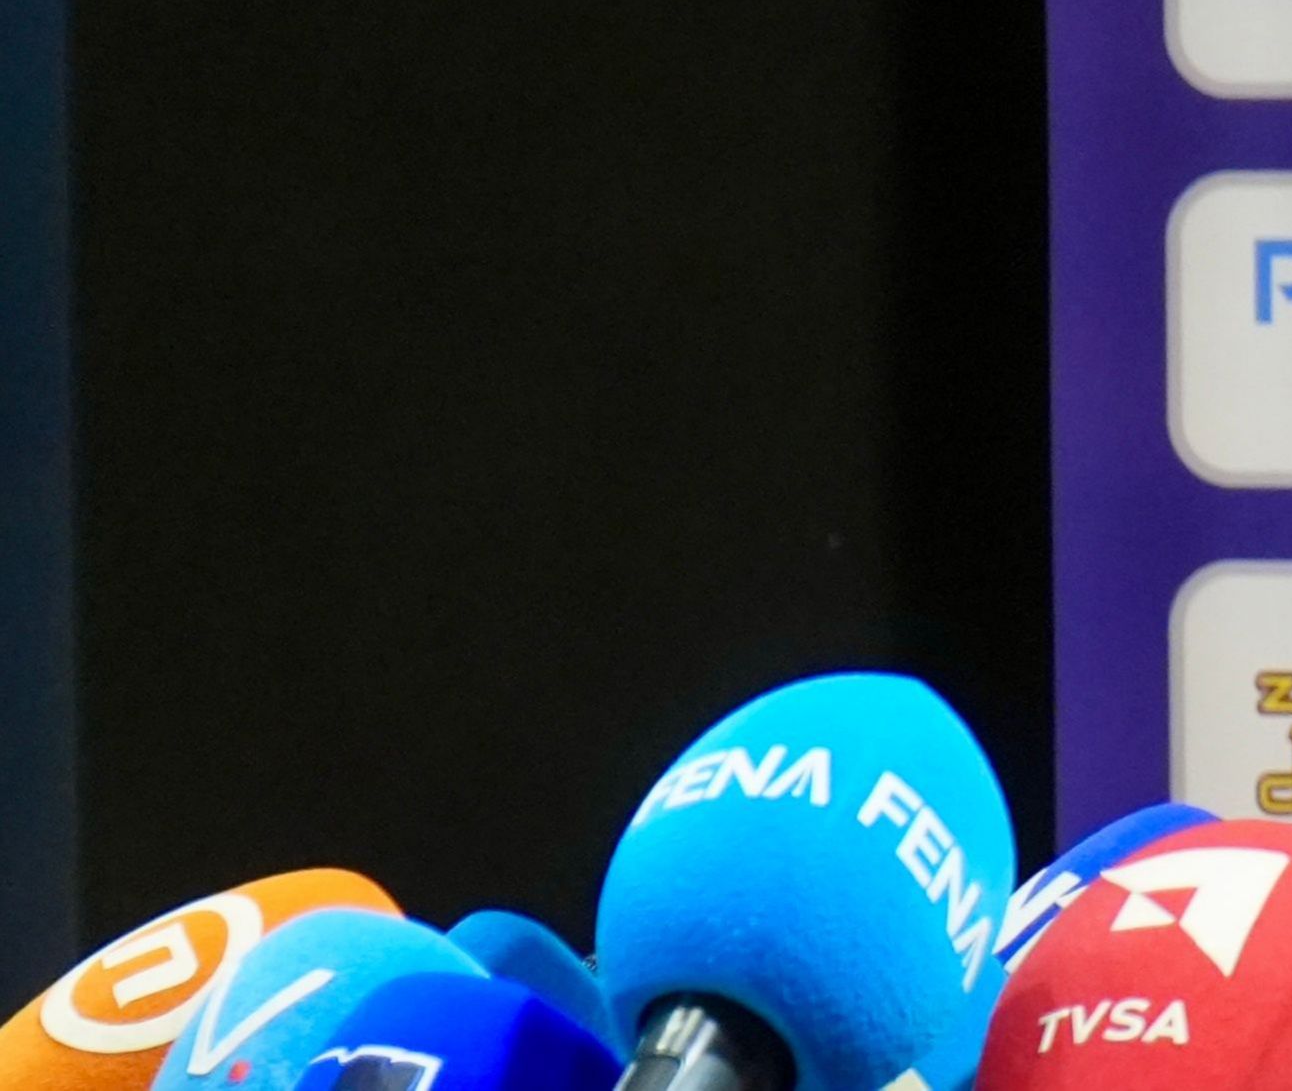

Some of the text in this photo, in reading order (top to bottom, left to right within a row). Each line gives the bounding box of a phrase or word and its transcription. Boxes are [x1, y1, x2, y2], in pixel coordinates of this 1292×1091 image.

[631, 744, 831, 828] FENA
[856, 770, 993, 993] FENA
[1036, 997, 1190, 1055] TVSA
